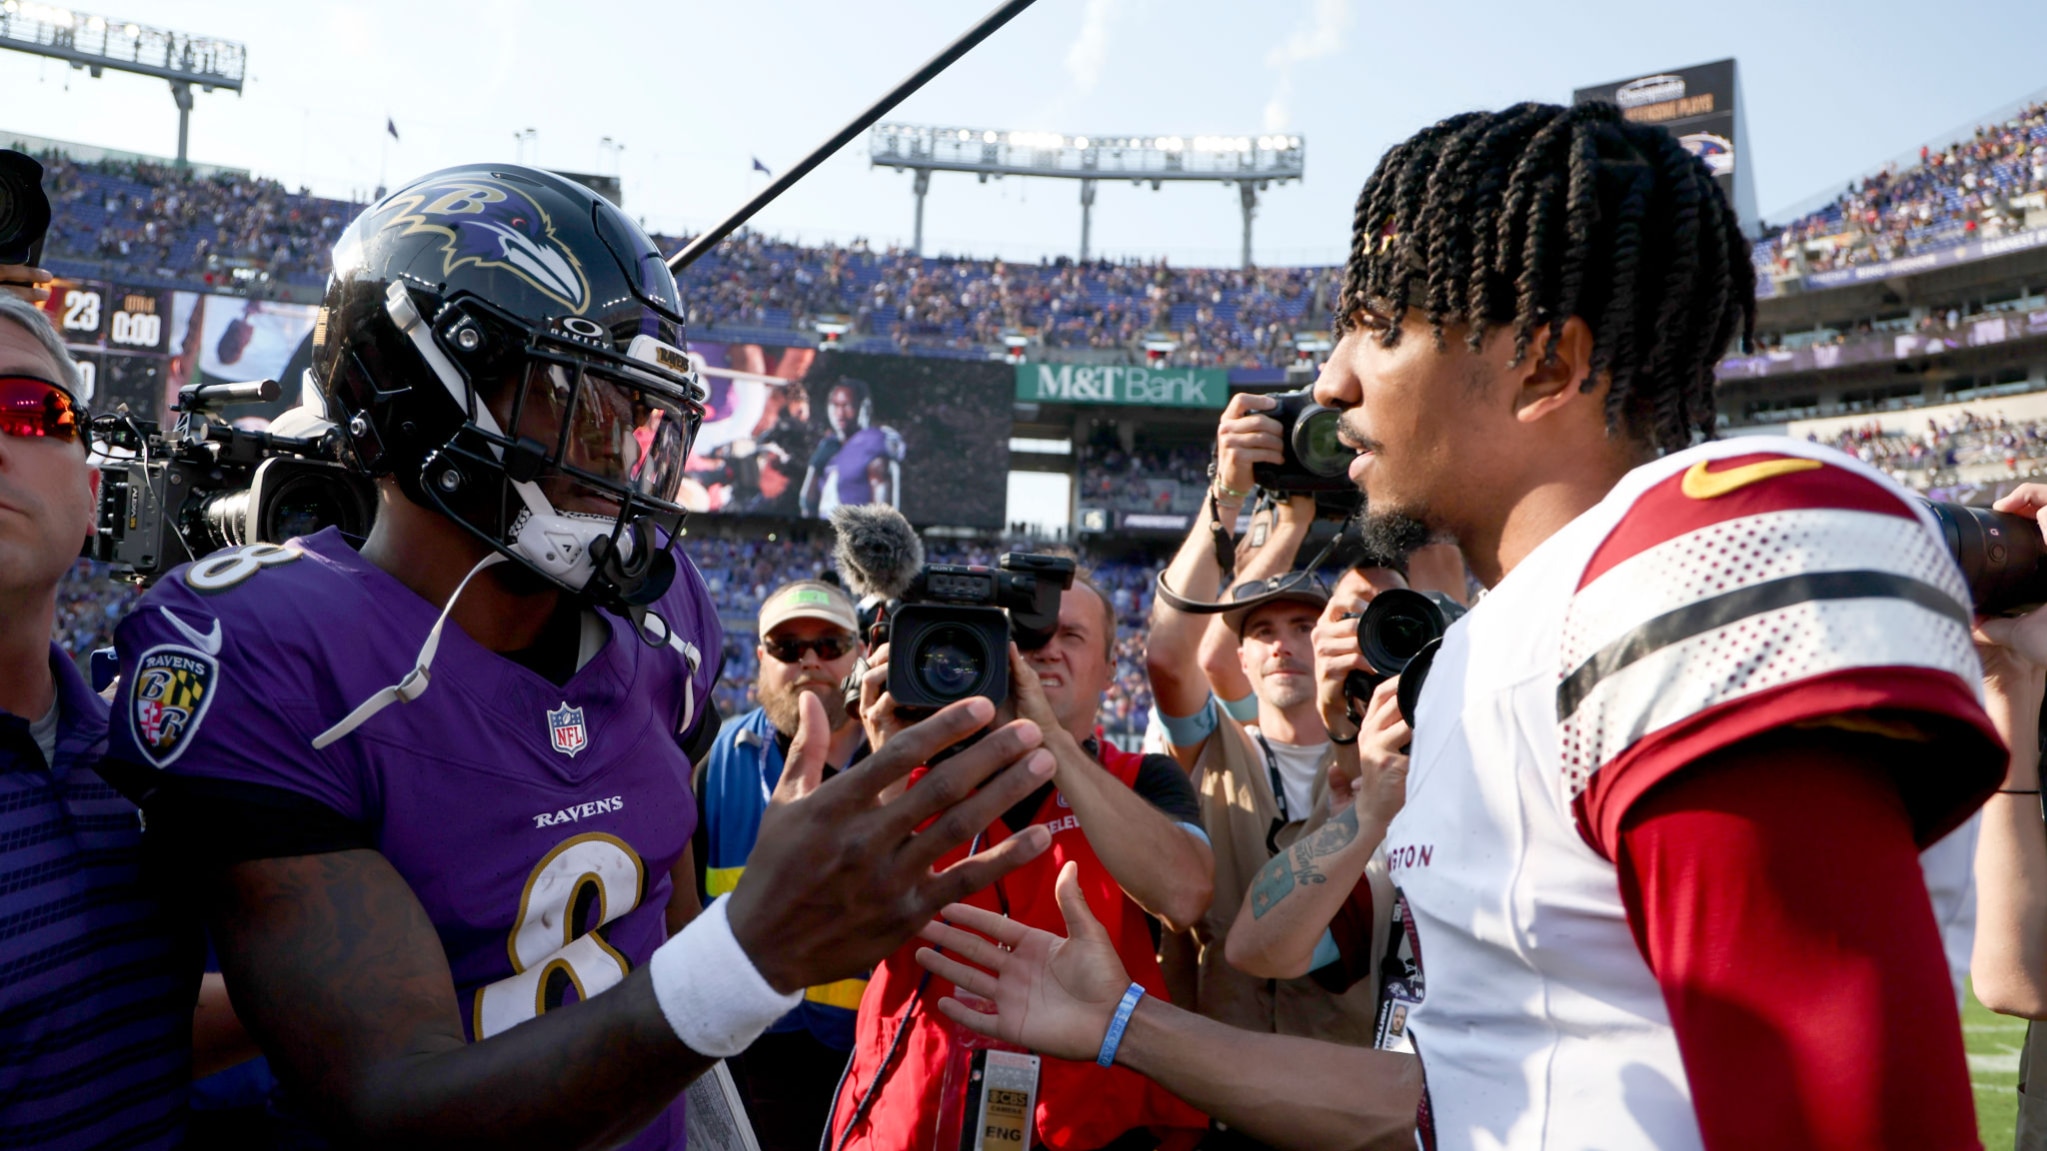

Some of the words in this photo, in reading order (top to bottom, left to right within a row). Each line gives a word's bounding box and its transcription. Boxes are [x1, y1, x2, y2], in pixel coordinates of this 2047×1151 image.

[63, 290, 100, 332] 23
[112, 311, 161, 347] 0:00
[656, 347, 689, 373] RAVENS
[1036, 365, 1123, 400] M&T
[1124, 367, 1208, 403] Bank
[185, 541, 304, 594] 8
[145, 655, 206, 676] RAVENS
[556, 726, 583, 748] NFL
[532, 796, 624, 829] RAVENS
[473, 831, 650, 1042] 8
[985, 1126, 1021, 1142] ENG
